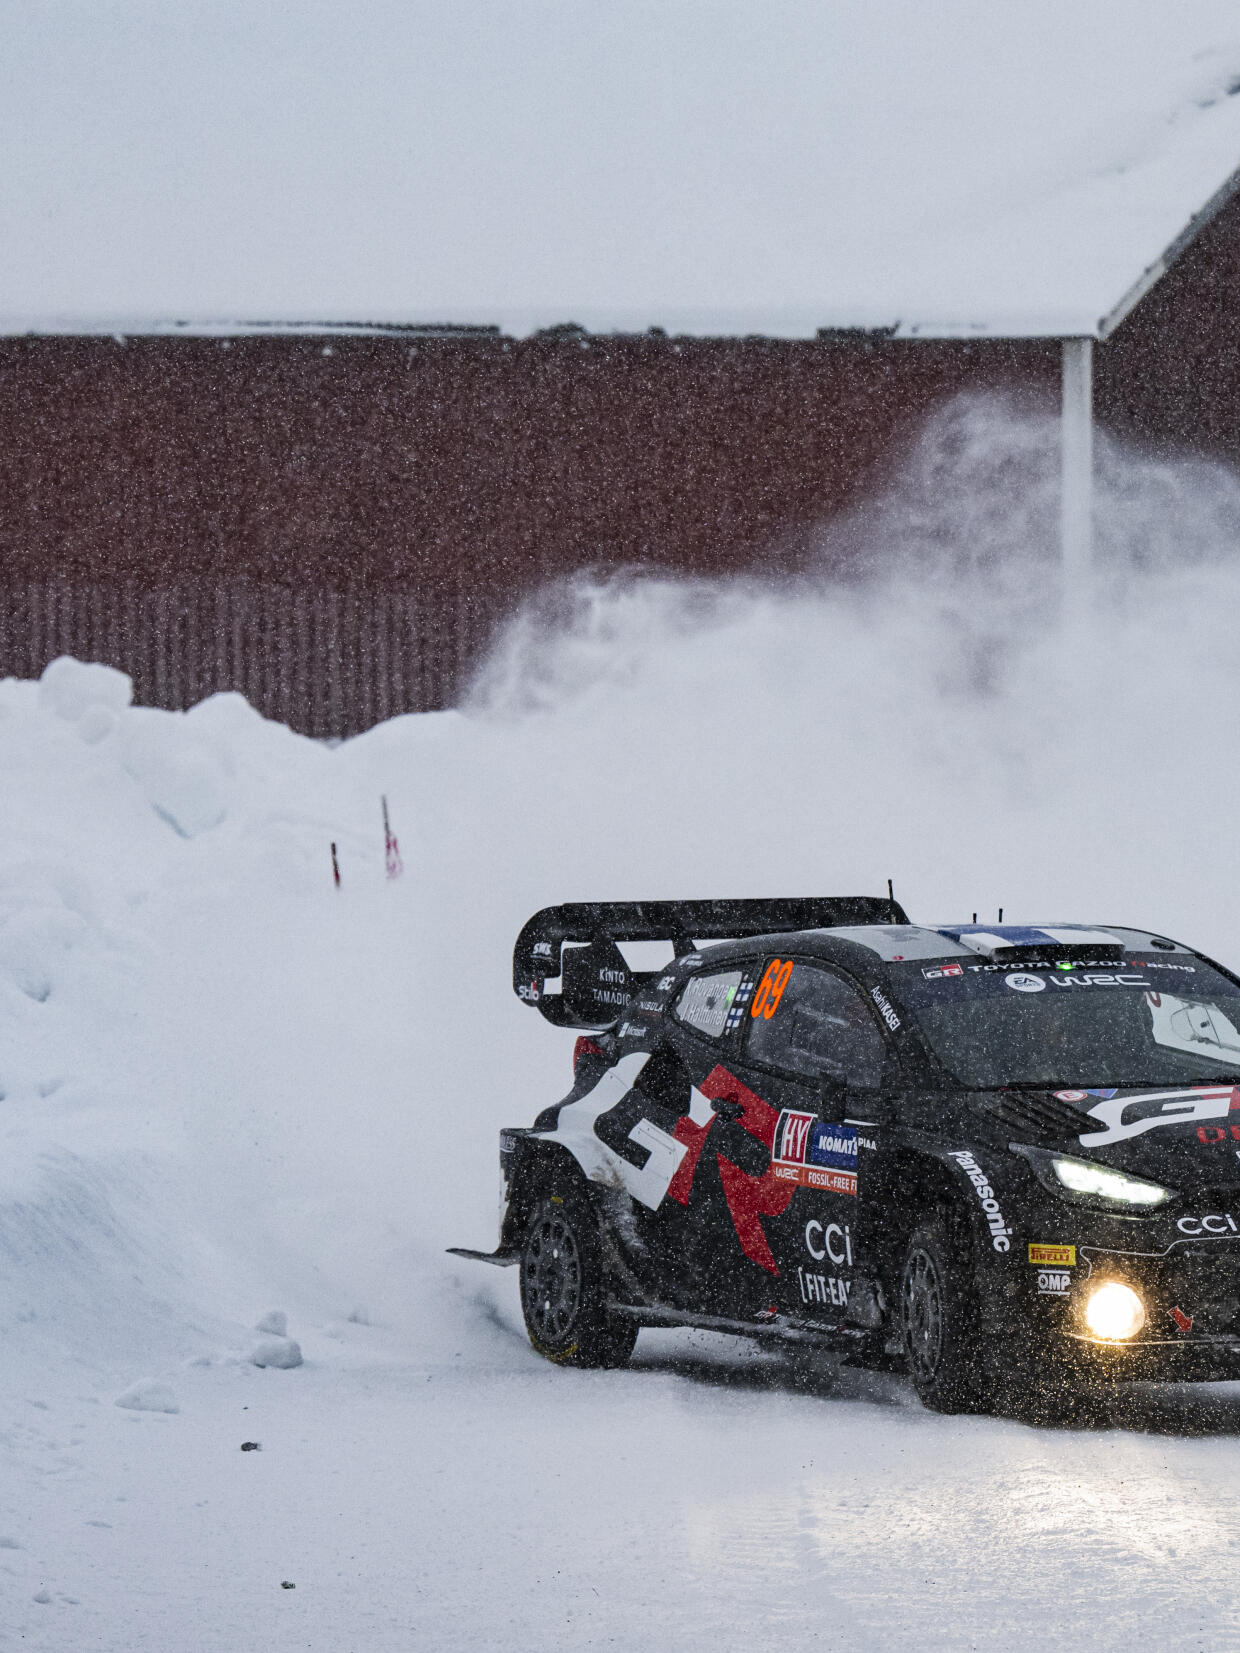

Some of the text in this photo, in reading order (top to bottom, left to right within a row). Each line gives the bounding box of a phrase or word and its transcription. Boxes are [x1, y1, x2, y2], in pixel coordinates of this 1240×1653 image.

[968, 962, 1051, 973] TOYOTA
[751, 958, 794, 1020] 69
[1049, 974, 1152, 987] WRC
[518, 980, 539, 1001] Stilo
[775, 1166, 799, 1181] WRC
[947, 1150, 1013, 1253] Panasonic
[1038, 1273, 1071, 1291] OMP
